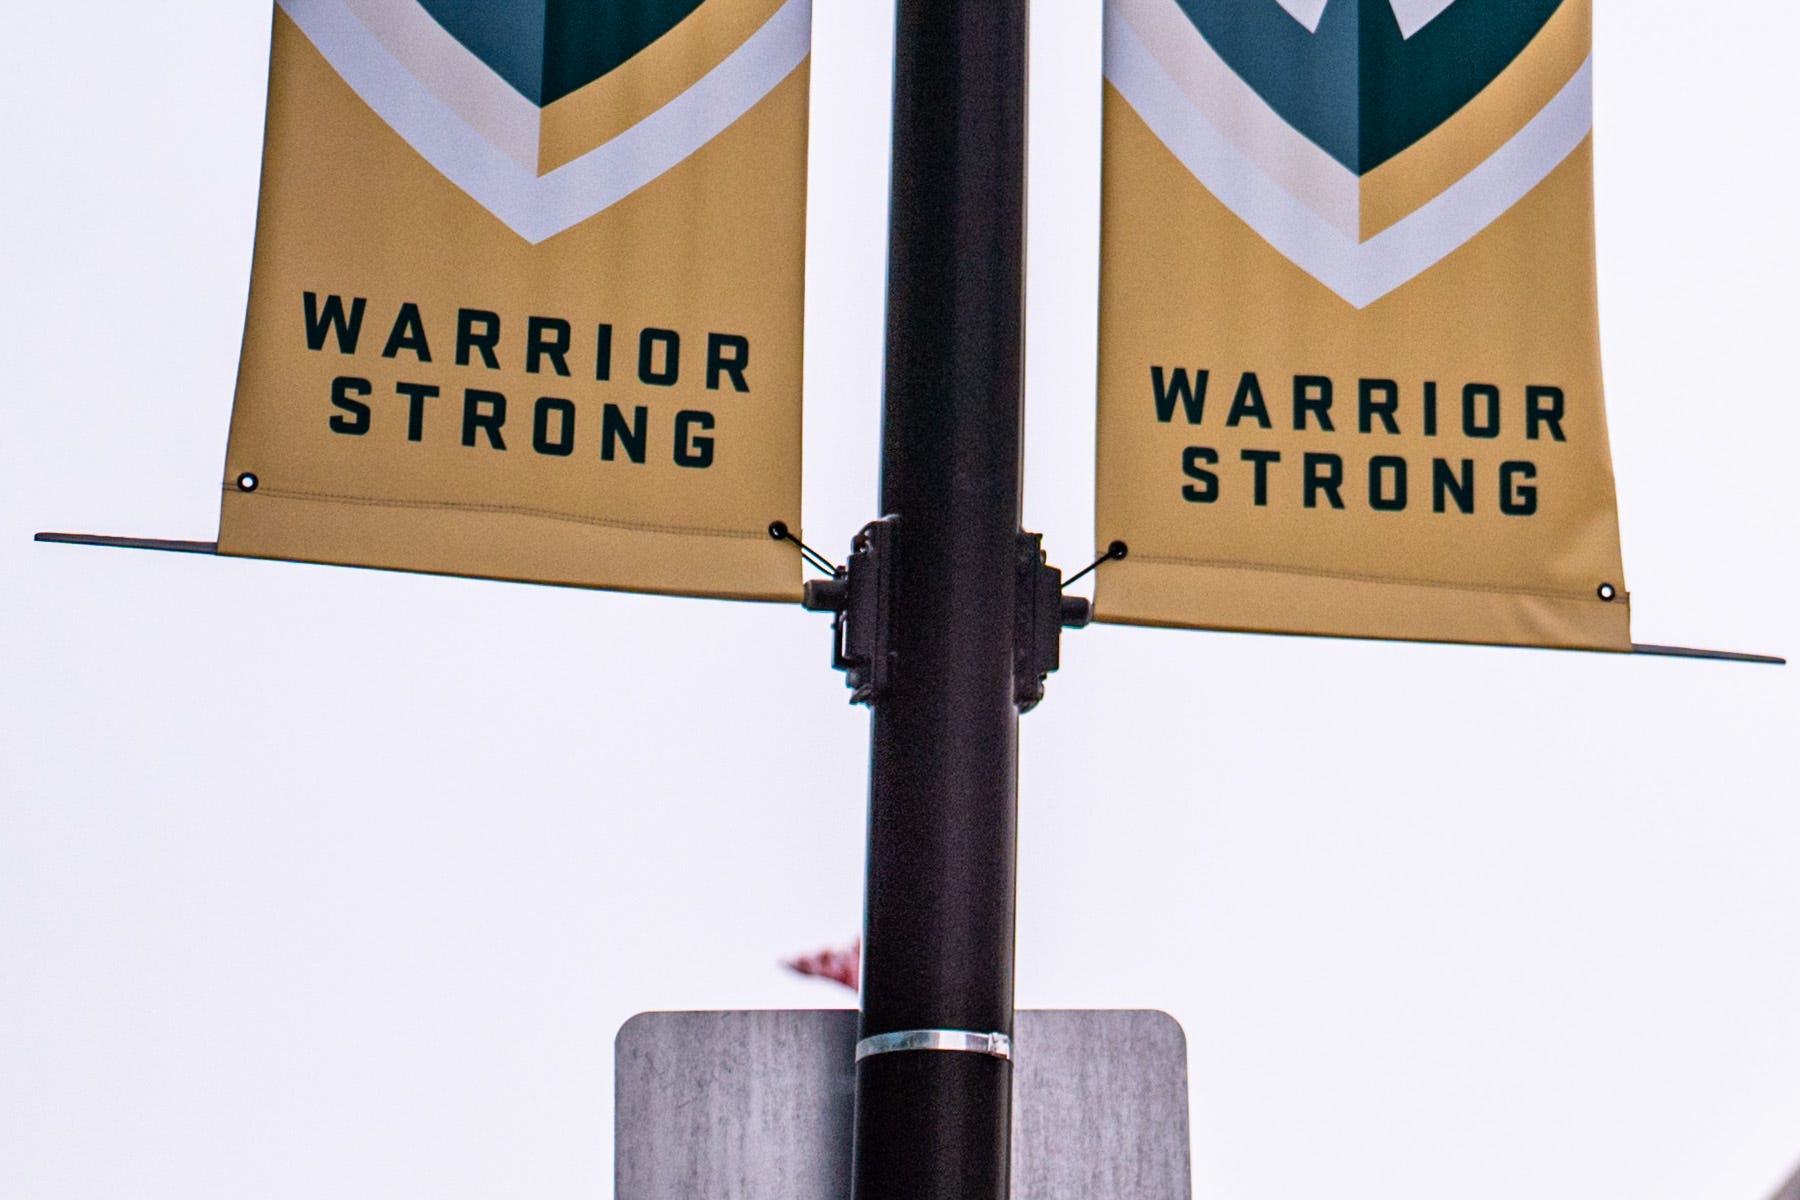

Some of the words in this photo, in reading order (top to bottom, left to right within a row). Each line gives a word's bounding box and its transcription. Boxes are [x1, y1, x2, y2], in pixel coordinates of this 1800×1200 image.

[301, 290, 751, 394] WARRIOR
[328, 374, 716, 470] STRONG
[1149, 364, 1568, 443] WARRIOR
[1180, 445, 1539, 518] STRONG
